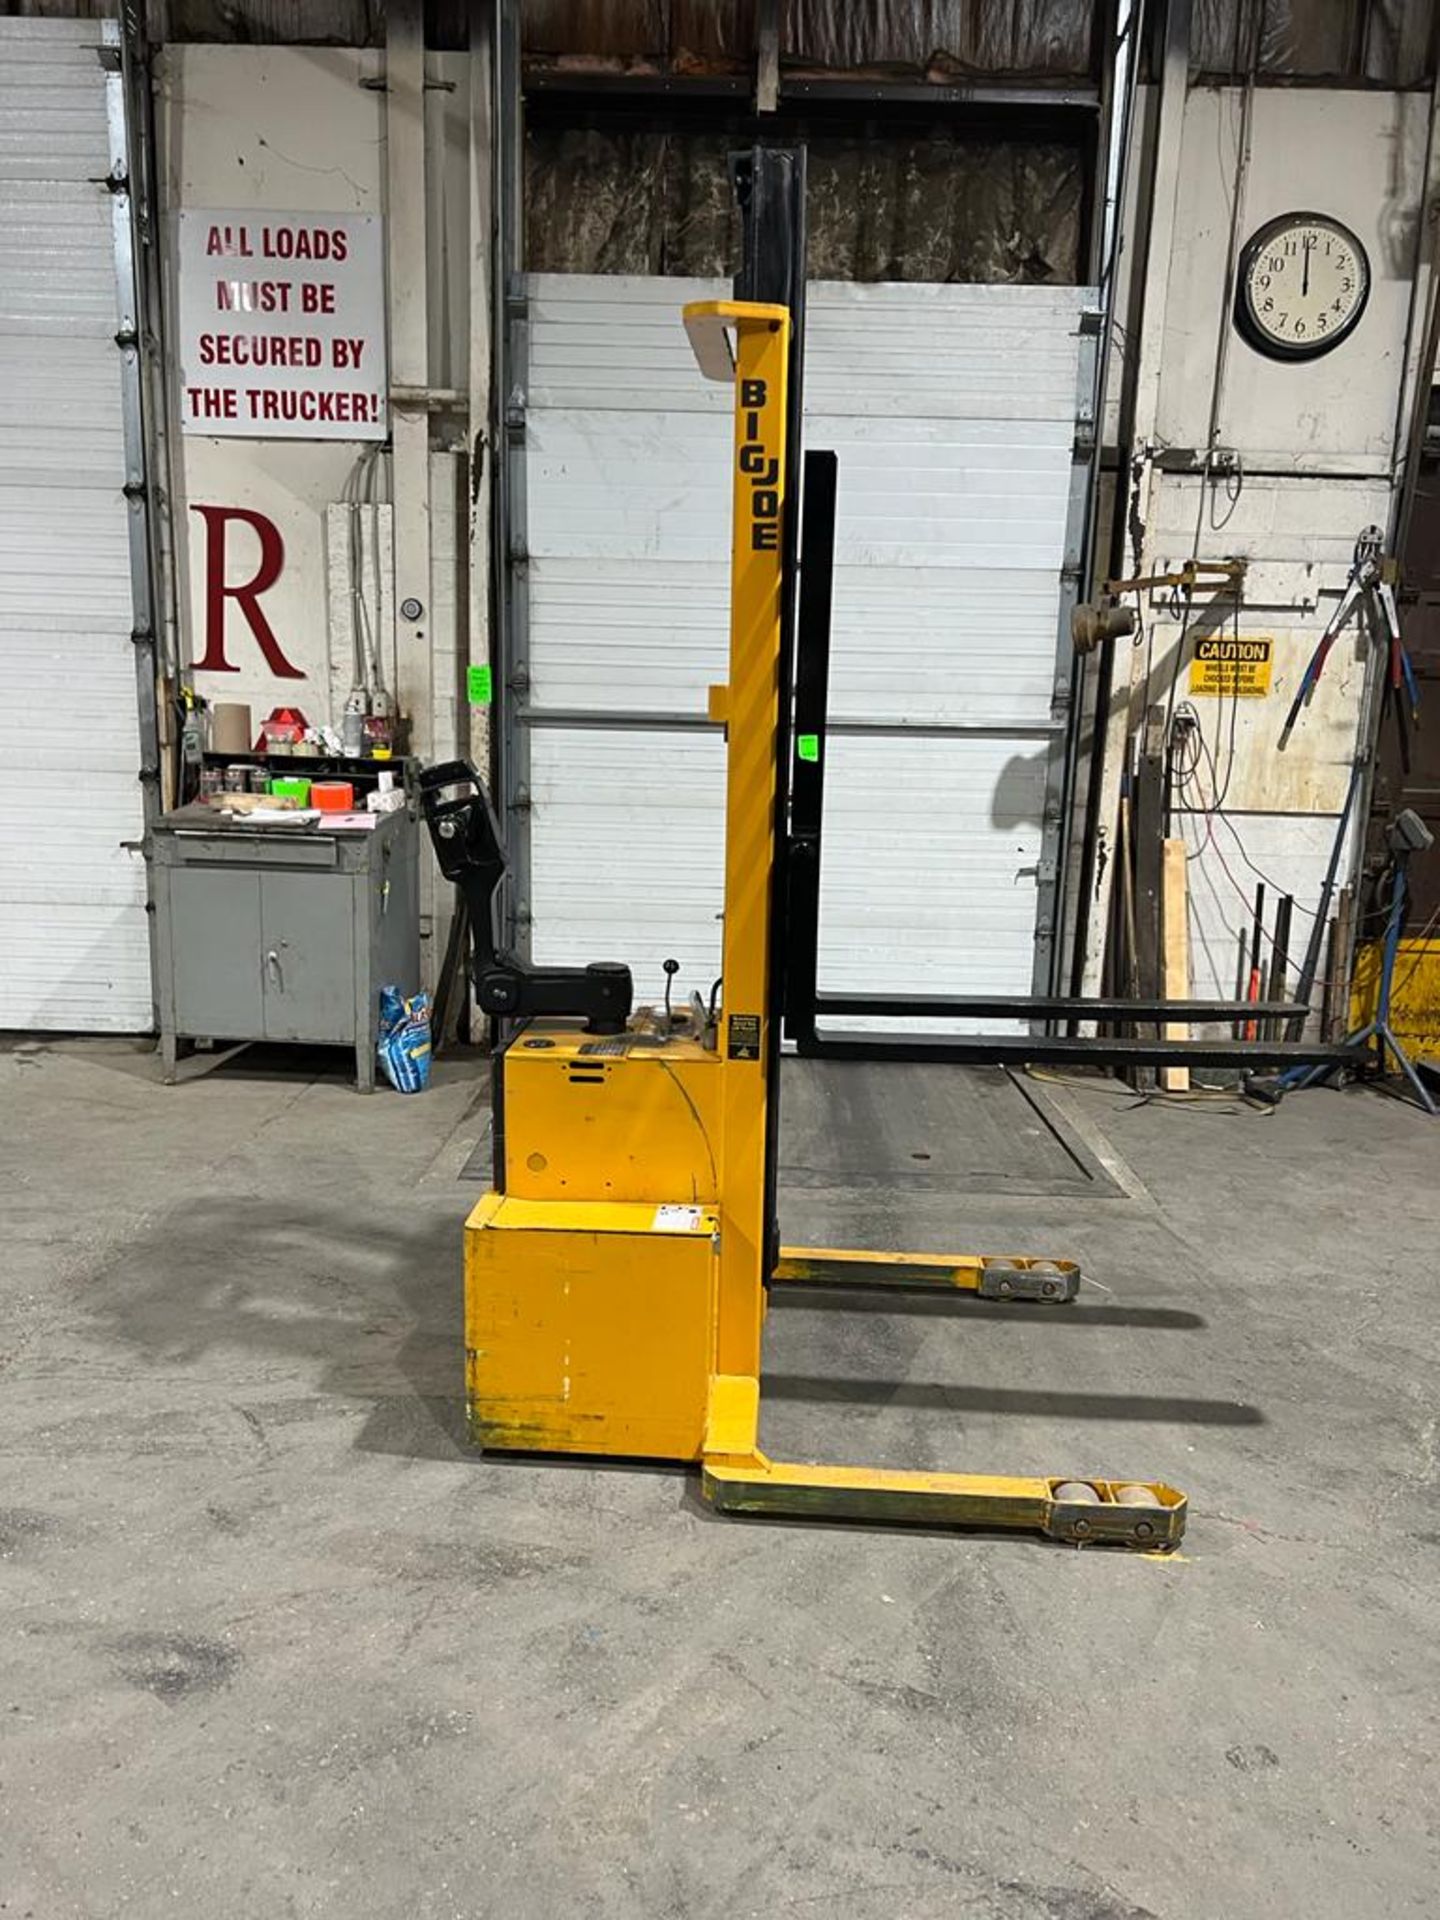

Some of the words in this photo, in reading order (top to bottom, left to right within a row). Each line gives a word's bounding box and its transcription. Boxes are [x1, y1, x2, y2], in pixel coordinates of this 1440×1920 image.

[207, 226, 253, 257] ALL
[263, 227, 348, 261] LOADS
[1284, 241, 1297, 256] 11
[1302, 235, 1318, 250] 12
[1325, 241, 1331, 256] 1
[1268, 257, 1285, 272] 10
[1336, 255, 1346, 270] 2
[1259, 275, 1271, 291] 9
[1341, 277, 1351, 293] 3
[217, 280, 292, 312] MUST
[302, 283, 335, 314] BE
[1263, 297, 1274, 312] 8
[1331, 298, 1342, 313] 4
[1279, 312, 1288, 328] 7
[1295, 317, 1306, 334] 6
[1317, 312, 1328, 329] 5
[200, 334, 321, 367] SECURED
[332, 339, 364, 369] BY
[187, 388, 237, 418] THE
[246, 389, 379, 423] TRUCKER!
[189, 504, 308, 680] R
[1200, 642, 1265, 660] CAUTION
